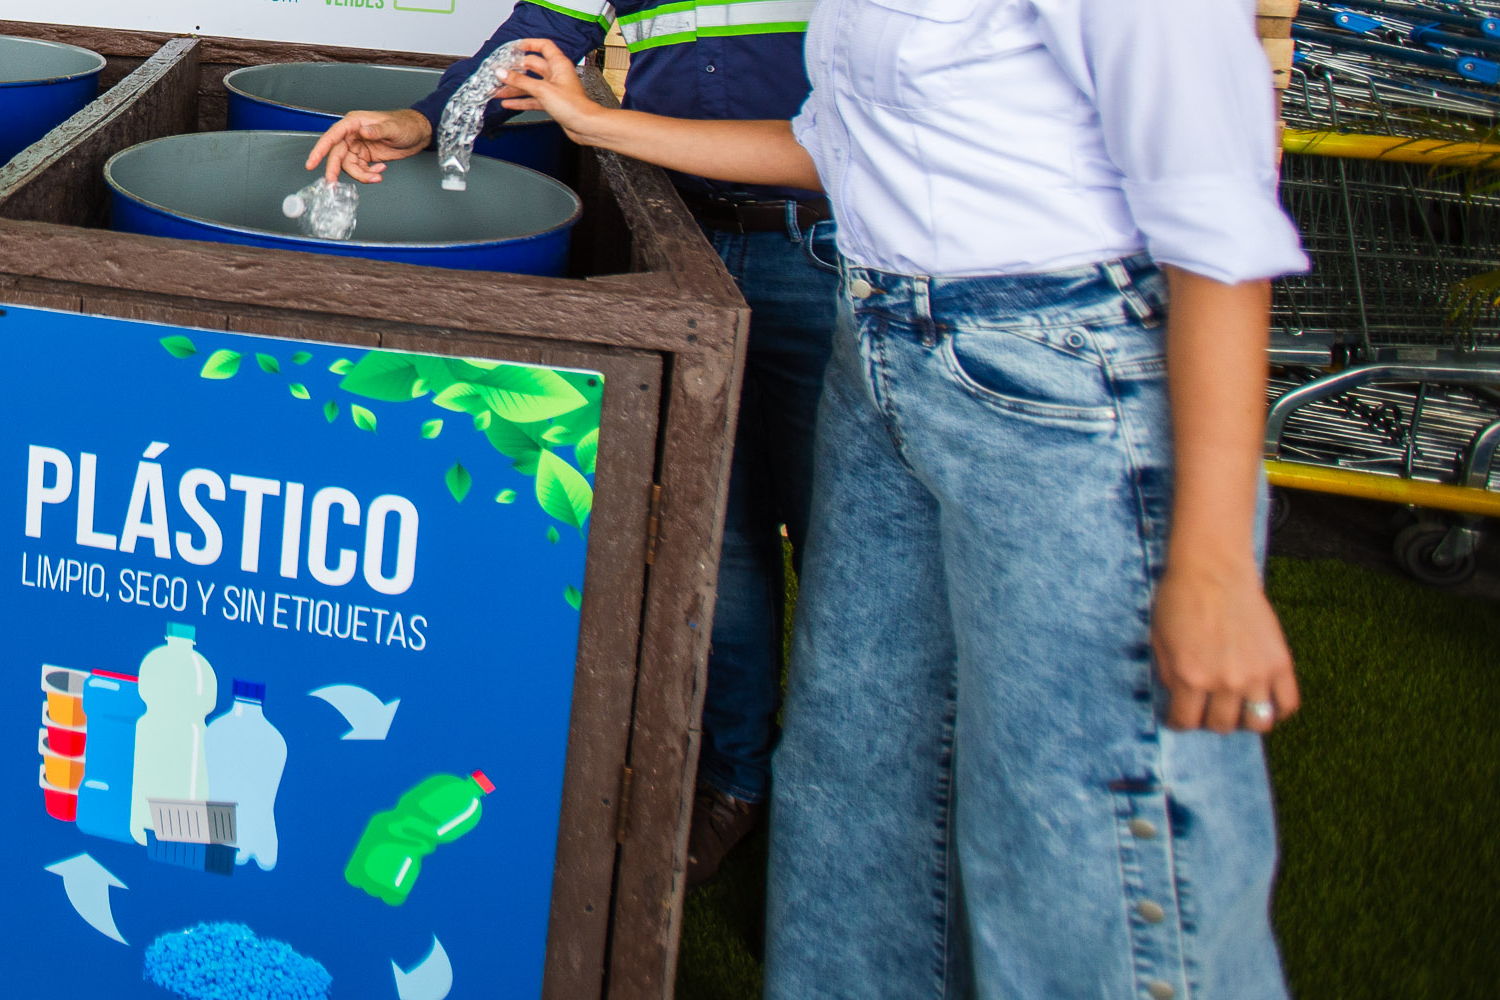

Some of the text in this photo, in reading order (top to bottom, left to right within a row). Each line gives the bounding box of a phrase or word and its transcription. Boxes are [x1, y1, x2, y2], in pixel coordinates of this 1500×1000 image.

[25, 441, 419, 595] PLÁSTICO
[22, 552, 428, 651] LIMPIO, SECO Y SIN ETIQUETAS
